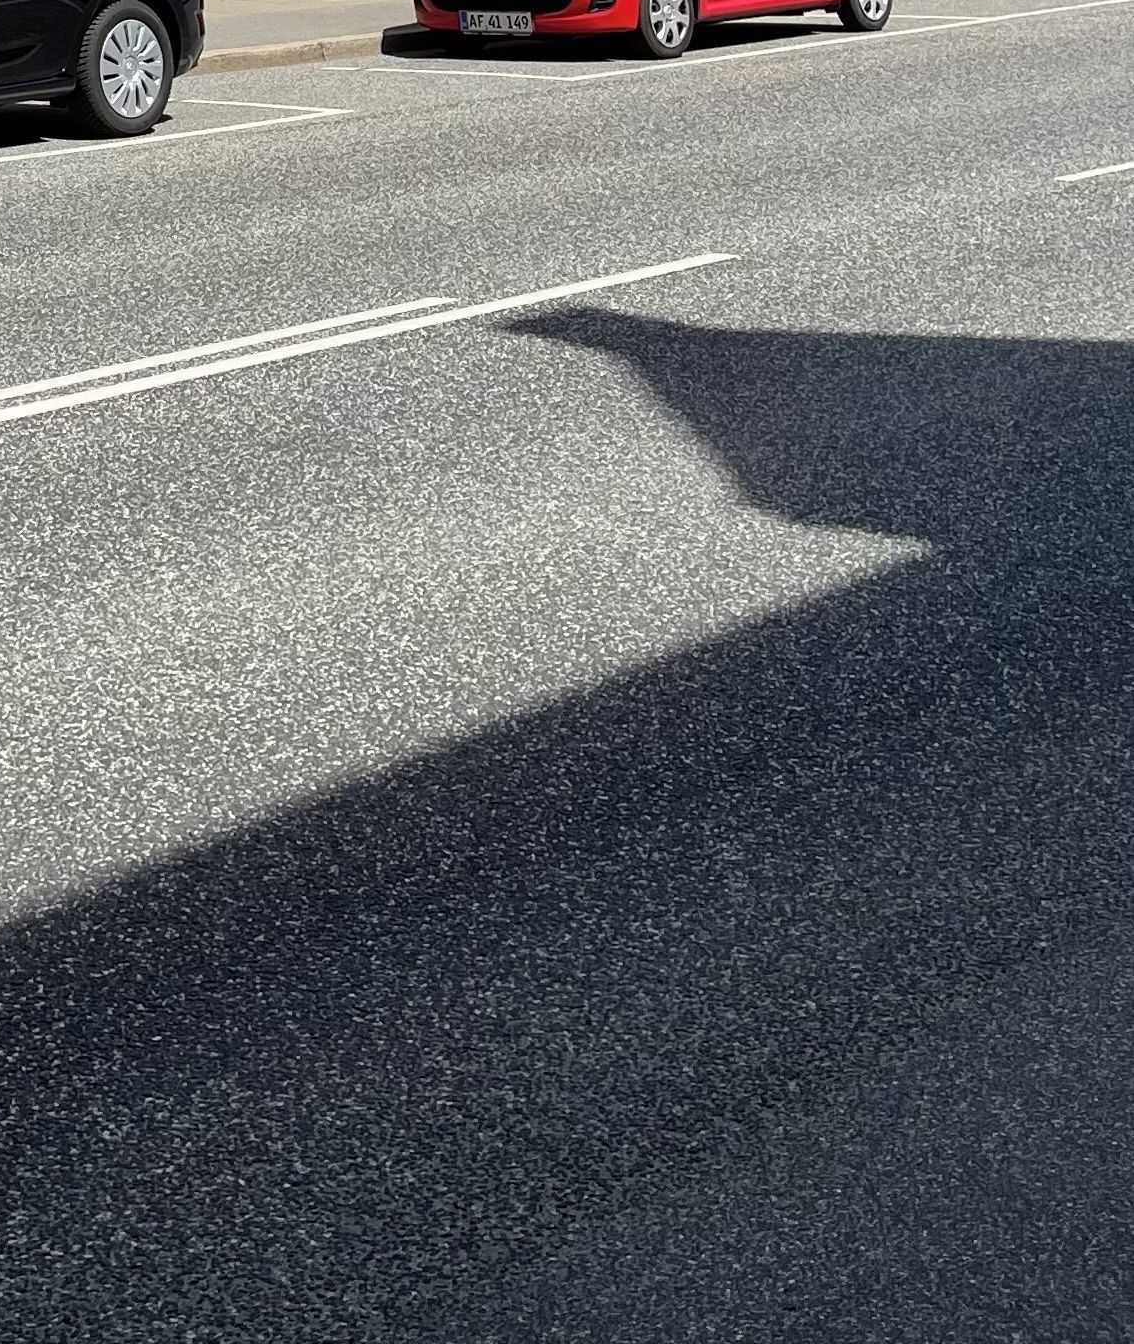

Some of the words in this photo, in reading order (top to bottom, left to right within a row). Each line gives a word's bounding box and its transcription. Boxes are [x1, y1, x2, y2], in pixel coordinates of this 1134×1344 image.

[470, 14, 484, 28] AF
[488, 14, 502, 29] 41
[506, 15, 529, 30] 149
